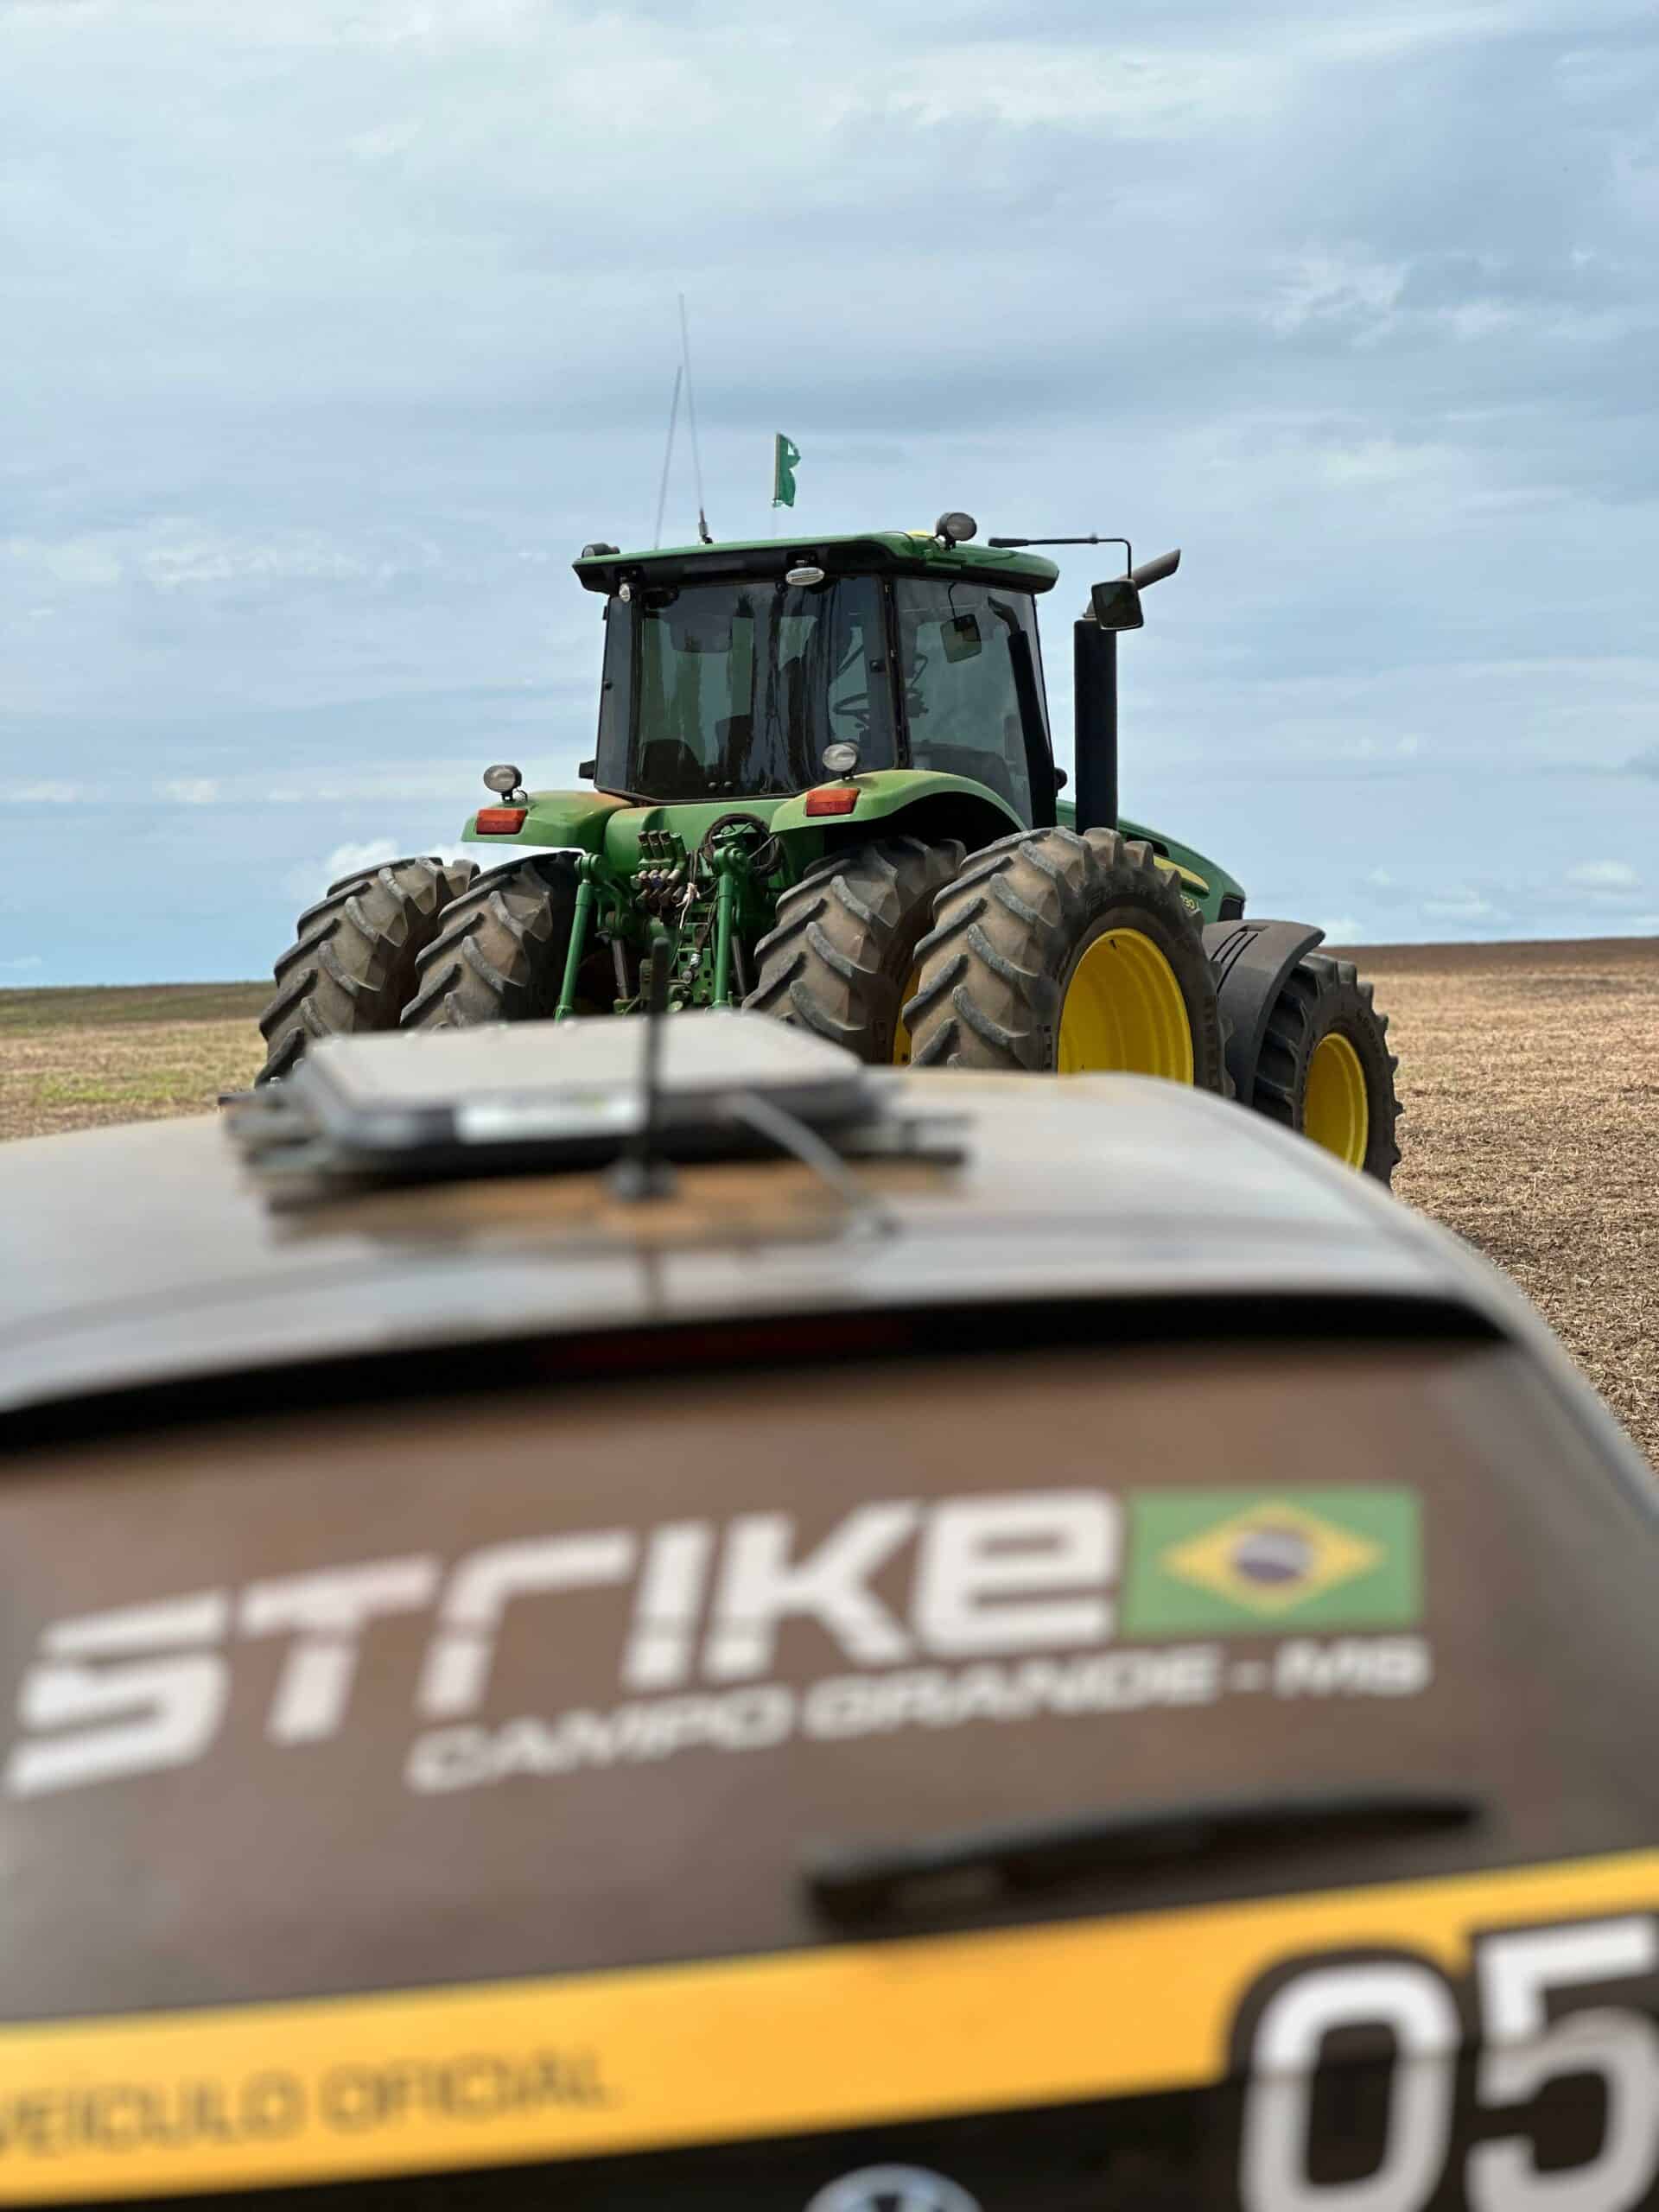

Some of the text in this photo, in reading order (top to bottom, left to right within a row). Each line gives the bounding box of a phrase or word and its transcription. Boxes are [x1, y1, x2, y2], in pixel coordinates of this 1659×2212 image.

[9, 1490, 1120, 1796] STRIKE
[406, 1683, 794, 1793] CAMPO
[804, 1643, 1220, 1739] GRANDE
[1273, 1637, 1435, 1700] MS
[1239, 1914, 1659, 2212] 05
